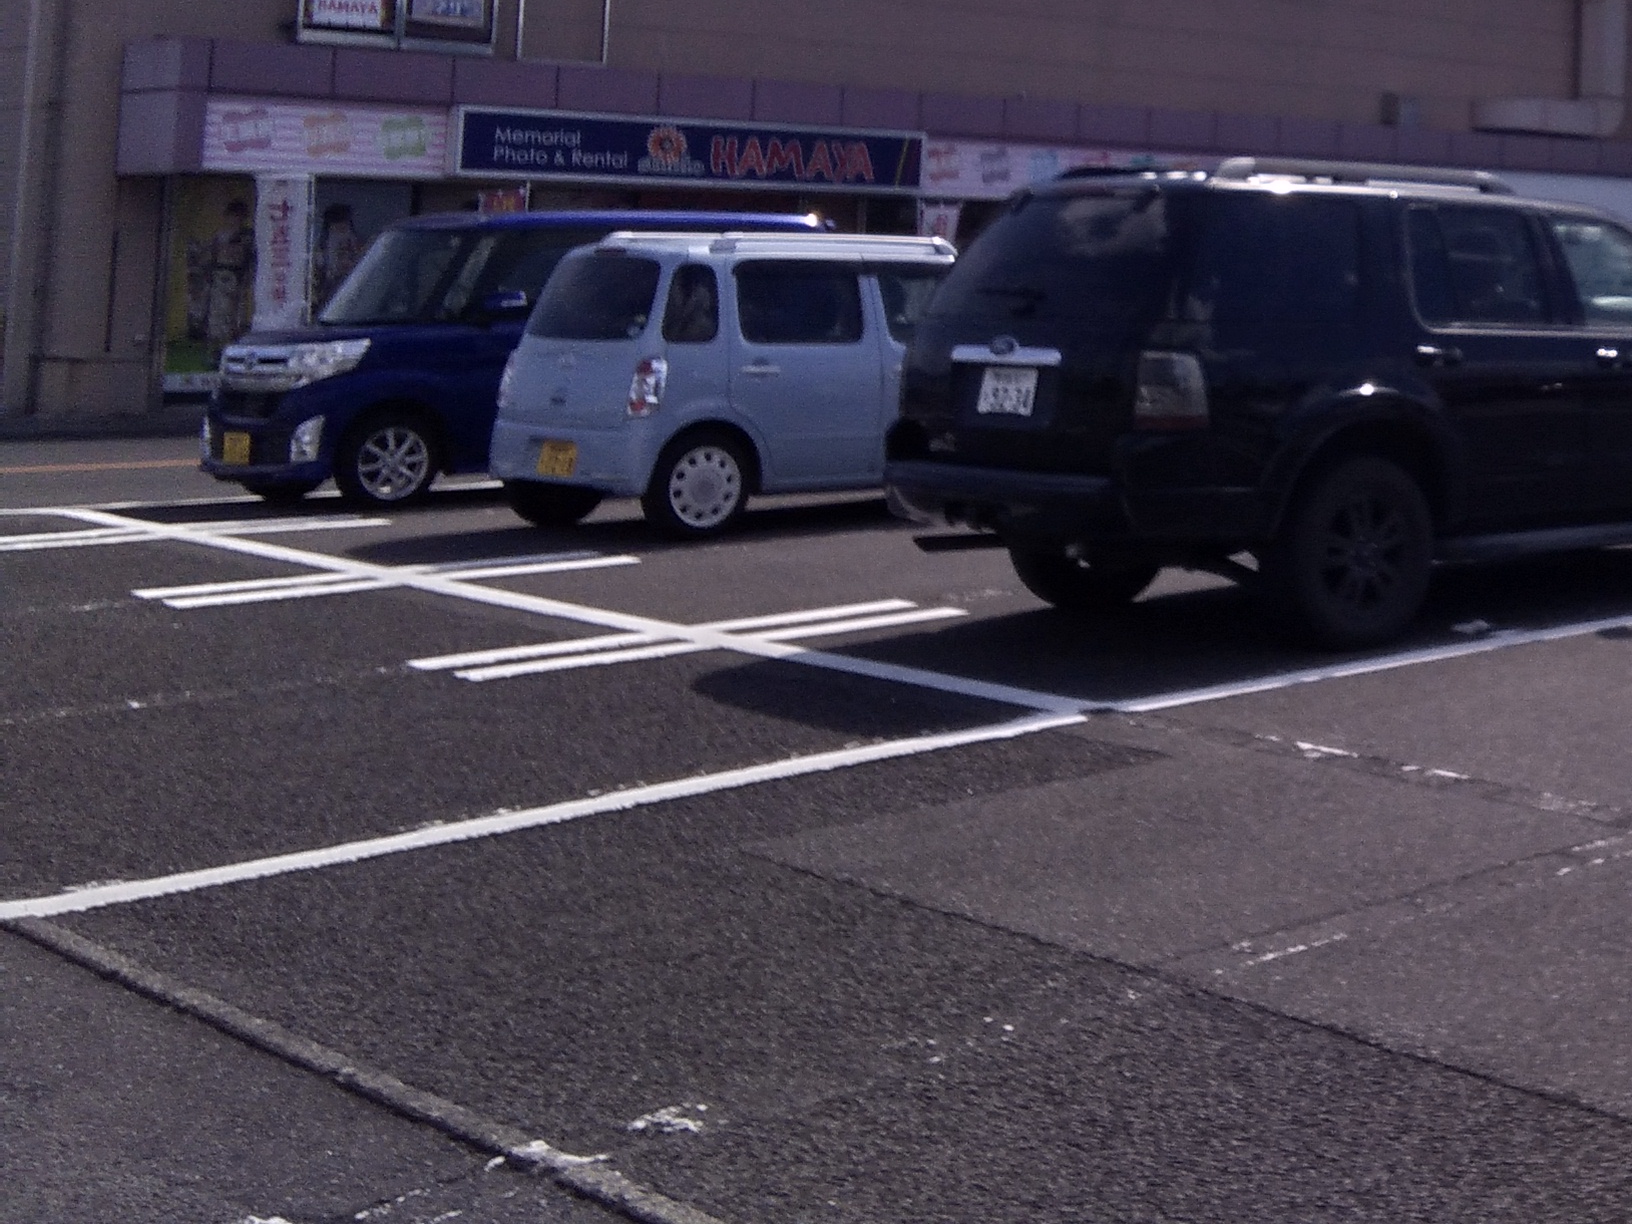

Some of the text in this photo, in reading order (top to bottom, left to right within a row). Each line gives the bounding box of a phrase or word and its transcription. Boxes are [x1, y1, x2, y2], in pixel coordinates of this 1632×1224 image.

[495, 126, 582, 146] Memorial
[493, 145, 549, 165] Photo
[553, 150, 566, 167] &
[571, 148, 629, 169] Rental
[710, 134, 875, 183] HAMAYA
